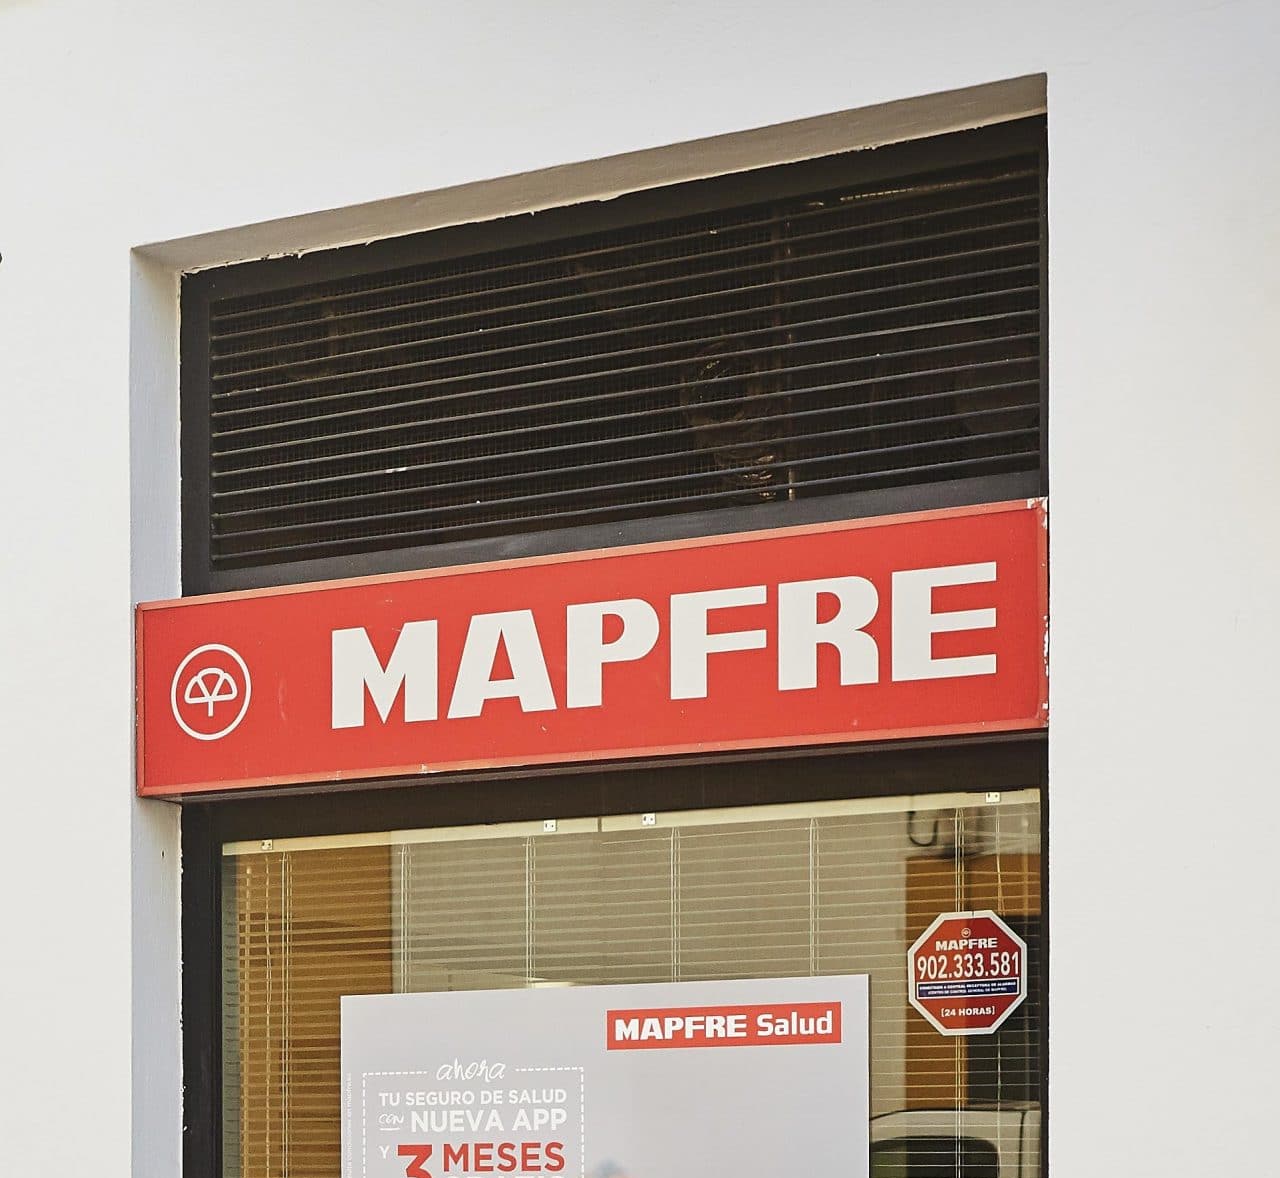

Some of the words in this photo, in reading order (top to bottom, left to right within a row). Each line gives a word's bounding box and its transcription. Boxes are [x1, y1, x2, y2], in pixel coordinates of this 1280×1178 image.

[331, 561, 997, 729] MAPFRE
[935, 937, 998, 951] MAPFRE
[917, 951, 1019, 980] 902.333.581
[614, 1014, 747, 1041] MAPFRE
[757, 1010, 833, 1037] Salud
[436, 1058, 506, 1082] ahora
[379, 1092, 401, 1106] TU
[405, 1091, 475, 1106] SEGURO
[480, 1090, 503, 1105] DE
[508, 1088, 567, 1104] SALUD
[378, 1113, 404, 1125] con
[411, 1109, 504, 1133] NUEVA
[511, 1108, 567, 1132] APP
[379, 1145, 390, 1159] Y
[443, 1142, 565, 1172] MESES
